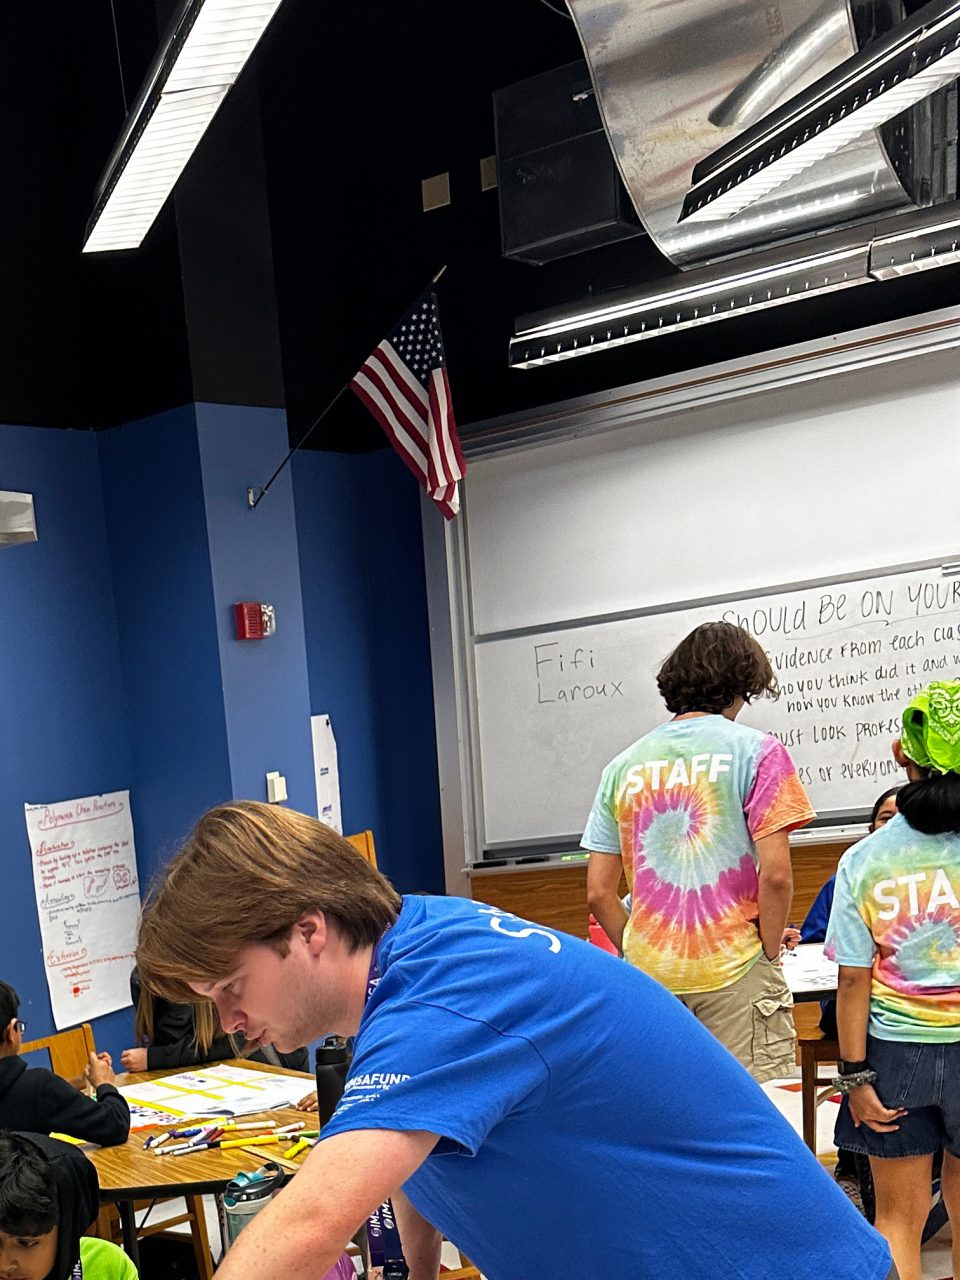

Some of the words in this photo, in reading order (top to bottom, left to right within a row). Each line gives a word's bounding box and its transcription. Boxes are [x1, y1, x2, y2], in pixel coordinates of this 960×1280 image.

[861, 590, 894, 618] ON
[534, 642, 597, 677] Fifi
[537, 678, 626, 704] Laroux
[625, 753, 734, 795] STAFF
